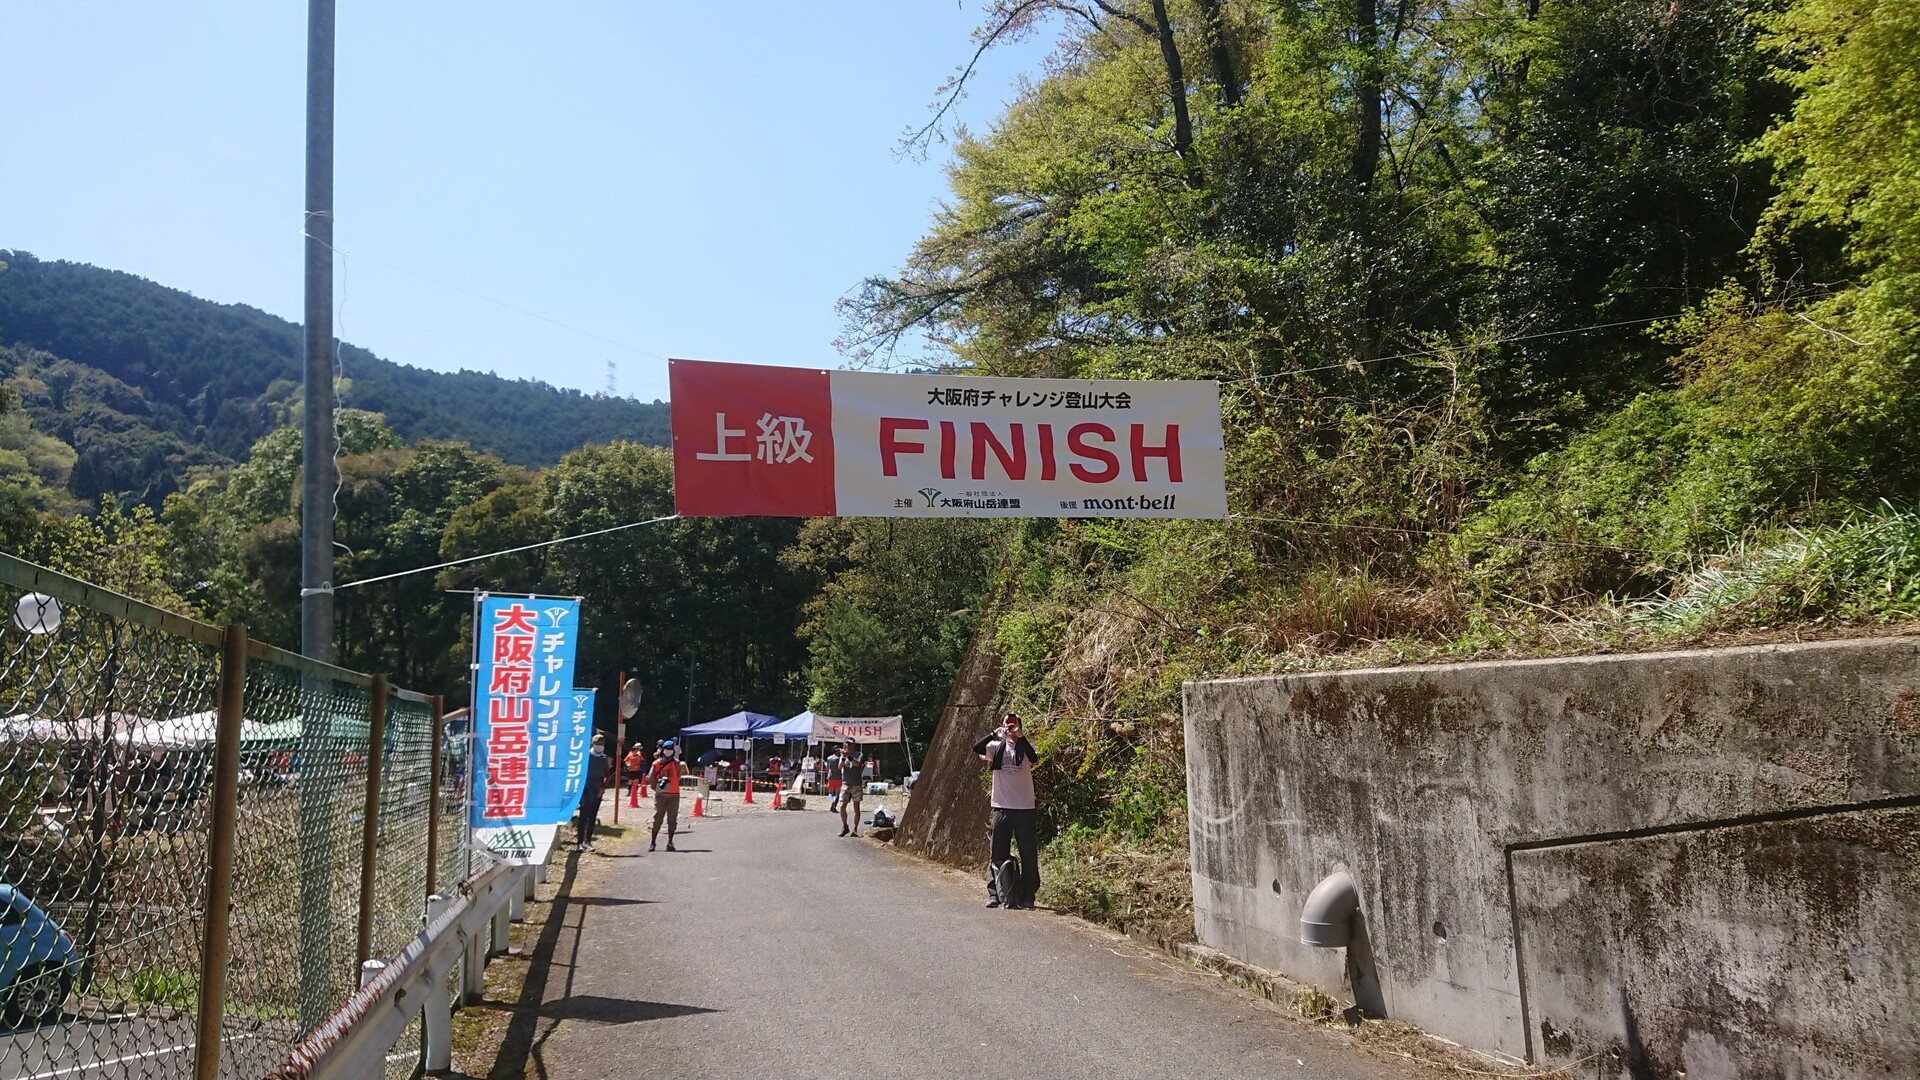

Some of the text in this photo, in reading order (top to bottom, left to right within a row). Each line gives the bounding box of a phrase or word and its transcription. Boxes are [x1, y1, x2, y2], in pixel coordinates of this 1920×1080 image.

[928, 387, 1132, 410] 大阪府チャレンジ登山大会
[696, 412, 815, 464] 上級
[879, 417, 1184, 484] FINISH
[894, 498, 913, 508] 主催
[940, 498, 1021, 509] 大阪府山岳連盟
[1060, 501, 1078, 509] 後援
[536, 631, 565, 768] チャレンジ!!
[484, 604, 537, 819] 大阪府山岳連盟
[832, 725, 882, 736] FINISH
[510, 850, 533, 858] TRAIL
